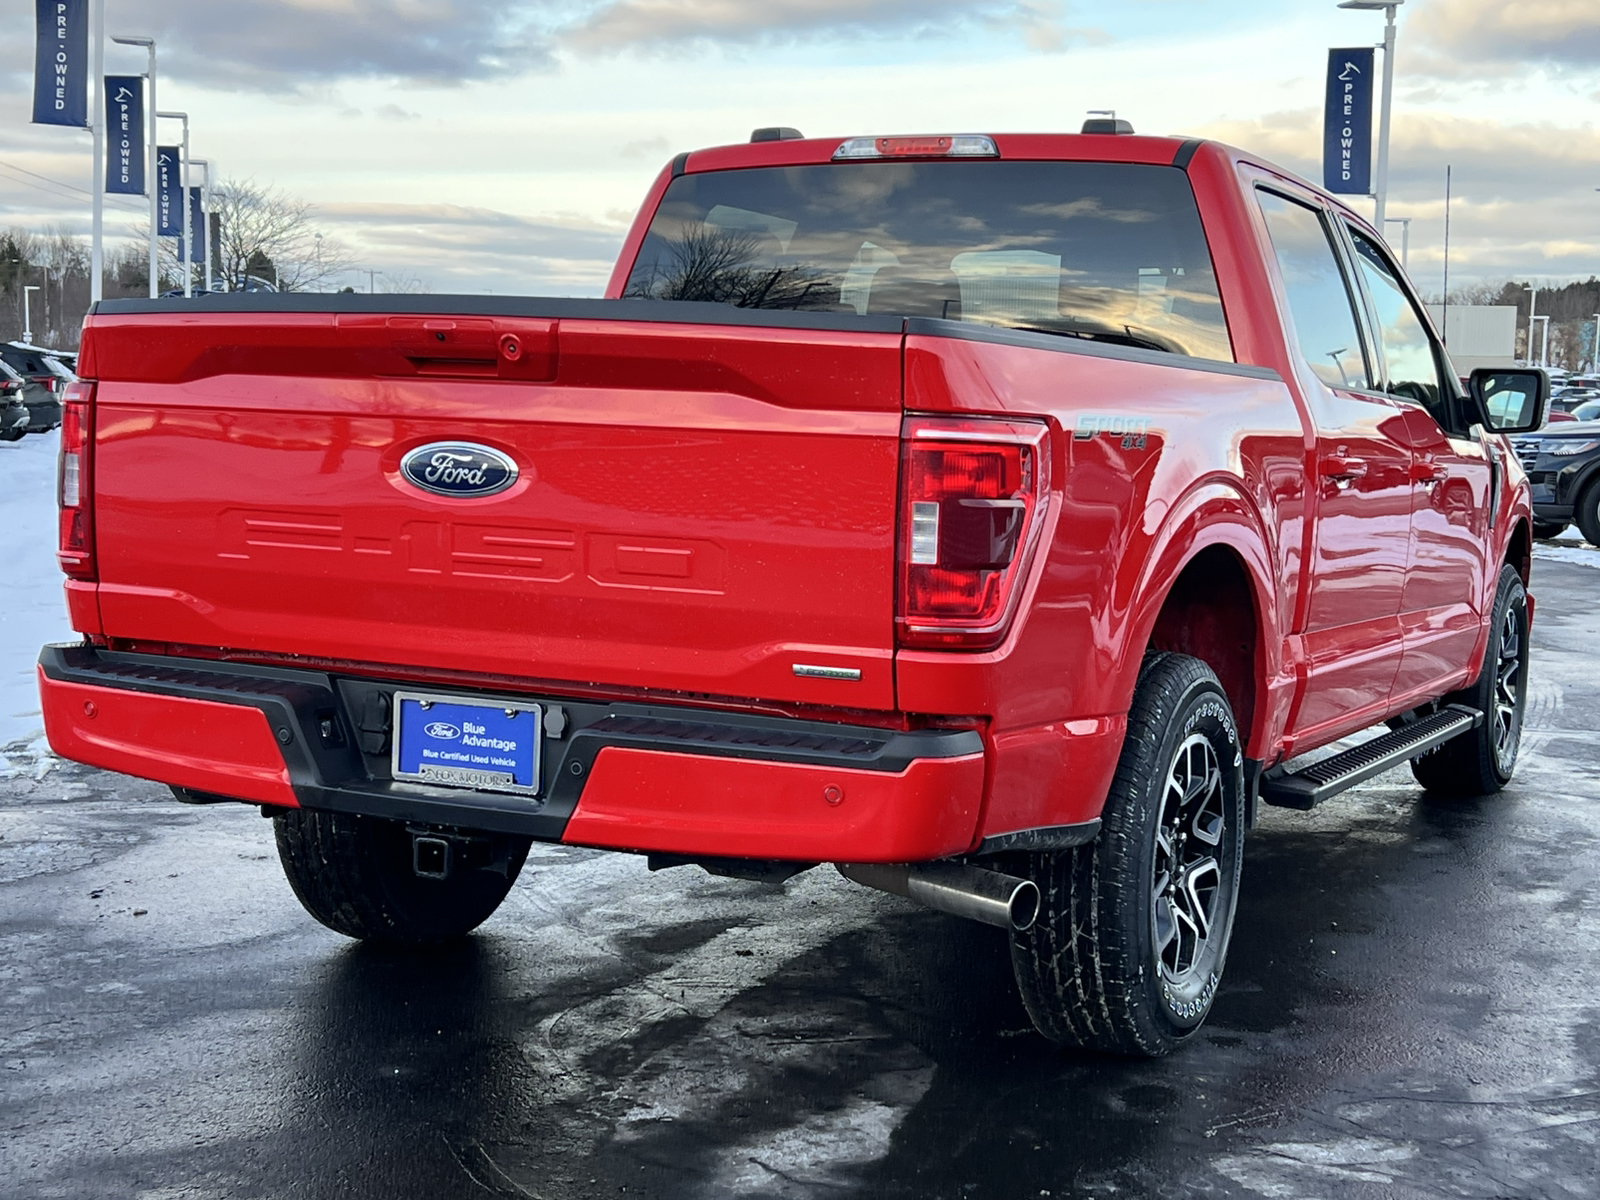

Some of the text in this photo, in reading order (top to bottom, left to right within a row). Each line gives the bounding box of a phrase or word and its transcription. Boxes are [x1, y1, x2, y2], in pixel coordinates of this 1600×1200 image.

[424, 452, 488, 486] Ford
[217, 506, 726, 594] F-150
[431, 723, 454, 737] Ford
[463, 722, 486, 734] Blue
[462, 734, 517, 752] Advantage
[422, 749, 516, 767] Blue Certified Used Vehicle
